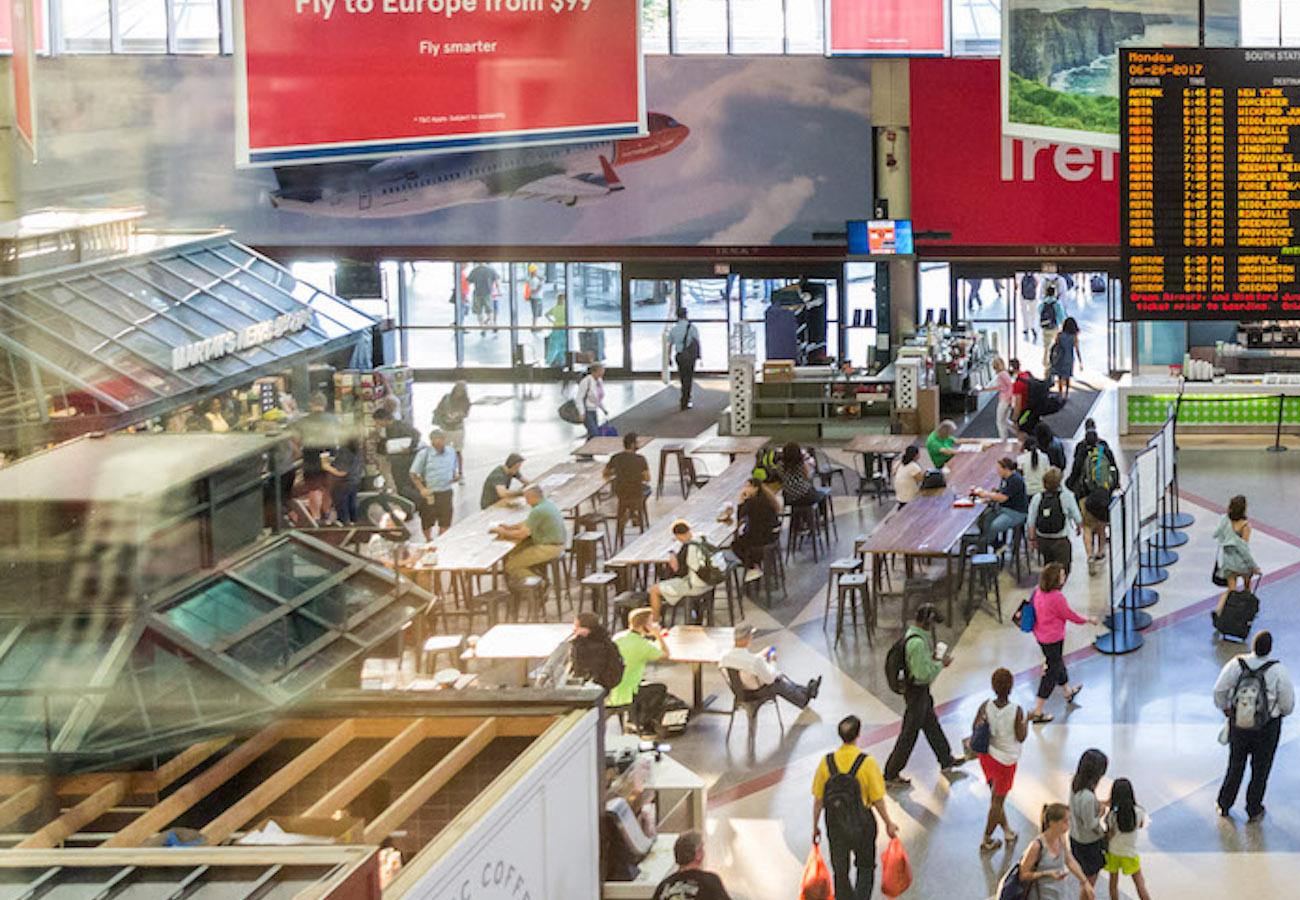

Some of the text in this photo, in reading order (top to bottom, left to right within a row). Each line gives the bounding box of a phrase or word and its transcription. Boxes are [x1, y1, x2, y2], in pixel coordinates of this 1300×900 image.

[296, 0, 592, 19] Fly to Europe from $99
[420, 41, 497, 56] Fly smarter
[1128, 52, 1174, 62] Monday
[1245, 51, 1276, 61] SOUTH
[1128, 64, 1204, 75] 06-26-2017
